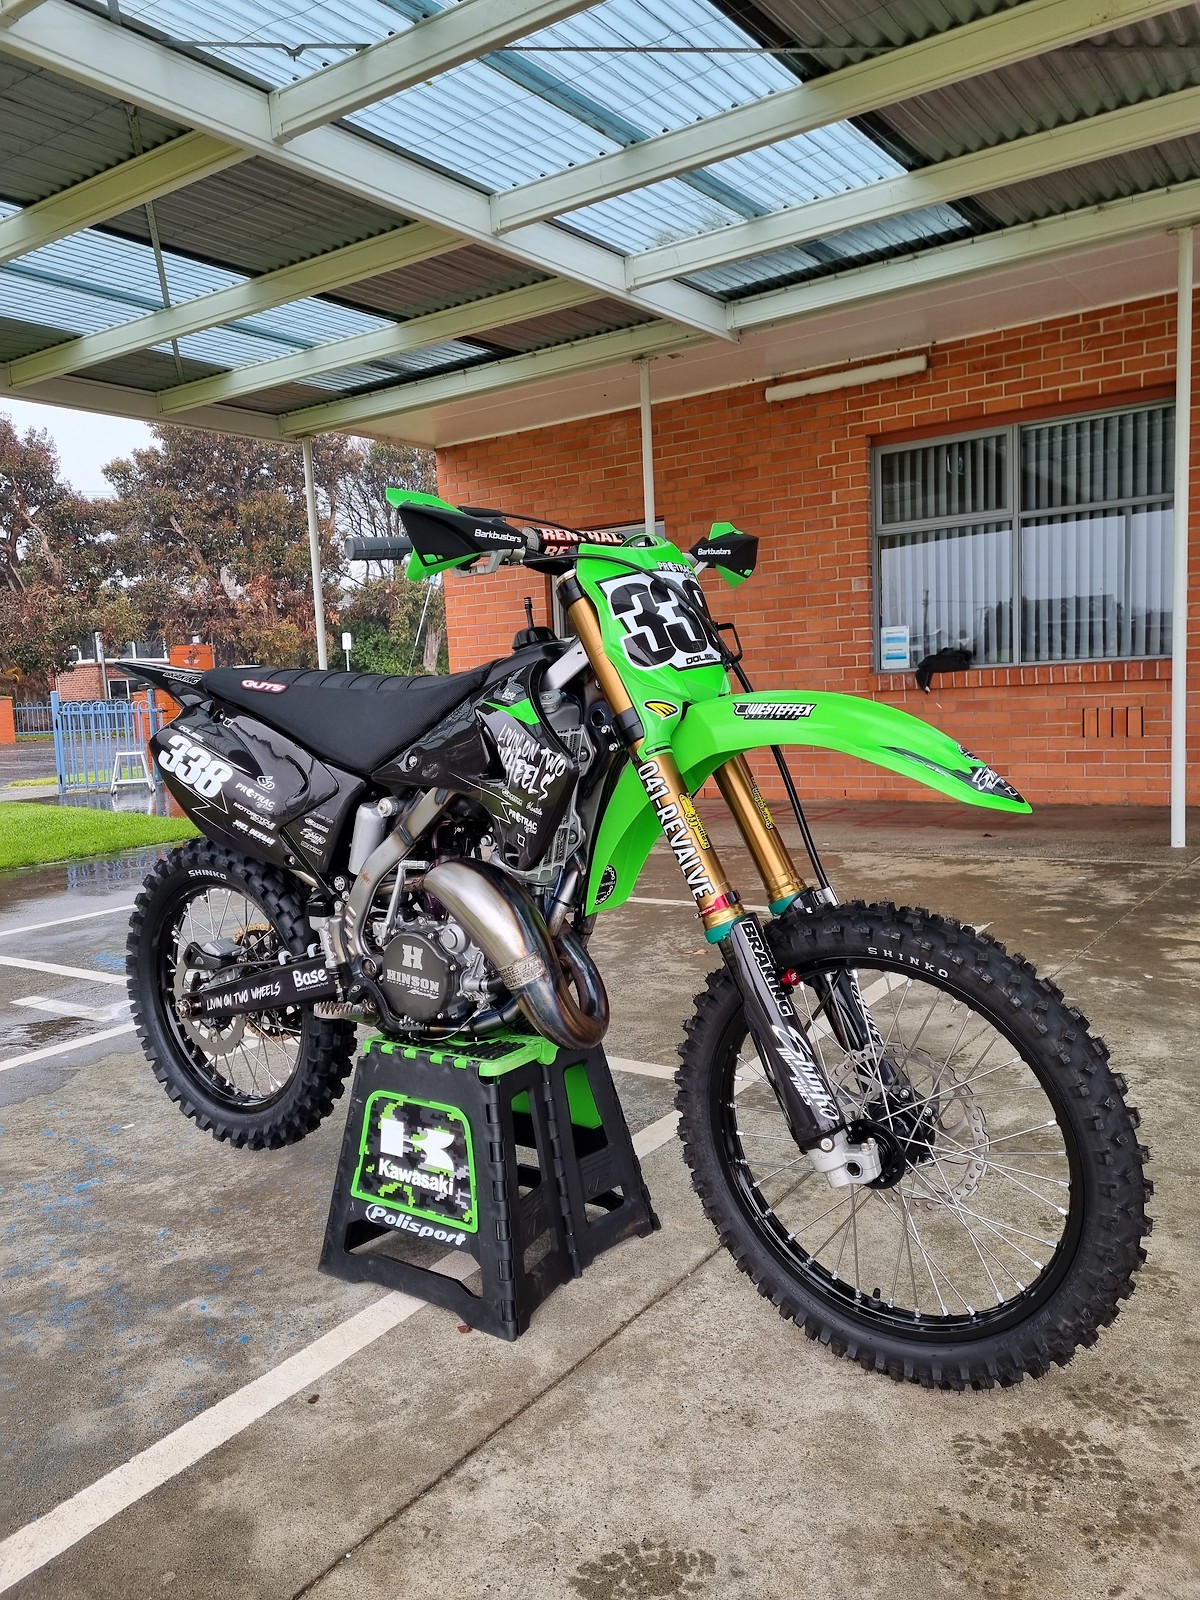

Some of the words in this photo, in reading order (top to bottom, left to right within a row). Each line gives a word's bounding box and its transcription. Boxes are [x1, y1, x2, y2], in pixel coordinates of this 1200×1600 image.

[474, 528, 522, 543] Barkbusters
[542, 528, 624, 543] RENTHAL
[697, 547, 732, 556] Barkbusters
[241, 679, 287, 692] GUTS
[747, 702, 816, 716] WESTEFFEX
[158, 735, 233, 798] 338
[521, 740, 541, 762] ON
[539, 747, 567, 779] TWO
[637, 759, 716, 901] 041-REVALVE
[188, 869, 227, 880] SHINKO
[402, 944, 423, 970] H
[739, 920, 794, 1017] BRAKING
[867, 946, 949, 978] SHINKO
[292, 968, 328, 988] Base
[387, 968, 440, 992] HINSON
[223, 993, 232, 1007] ON
[233, 989, 249, 1004] TWO
[250, 981, 281, 1001] WHEELS
[379, 1158, 455, 1196] Kawasaki
[366, 1203, 467, 1246] Polisport
